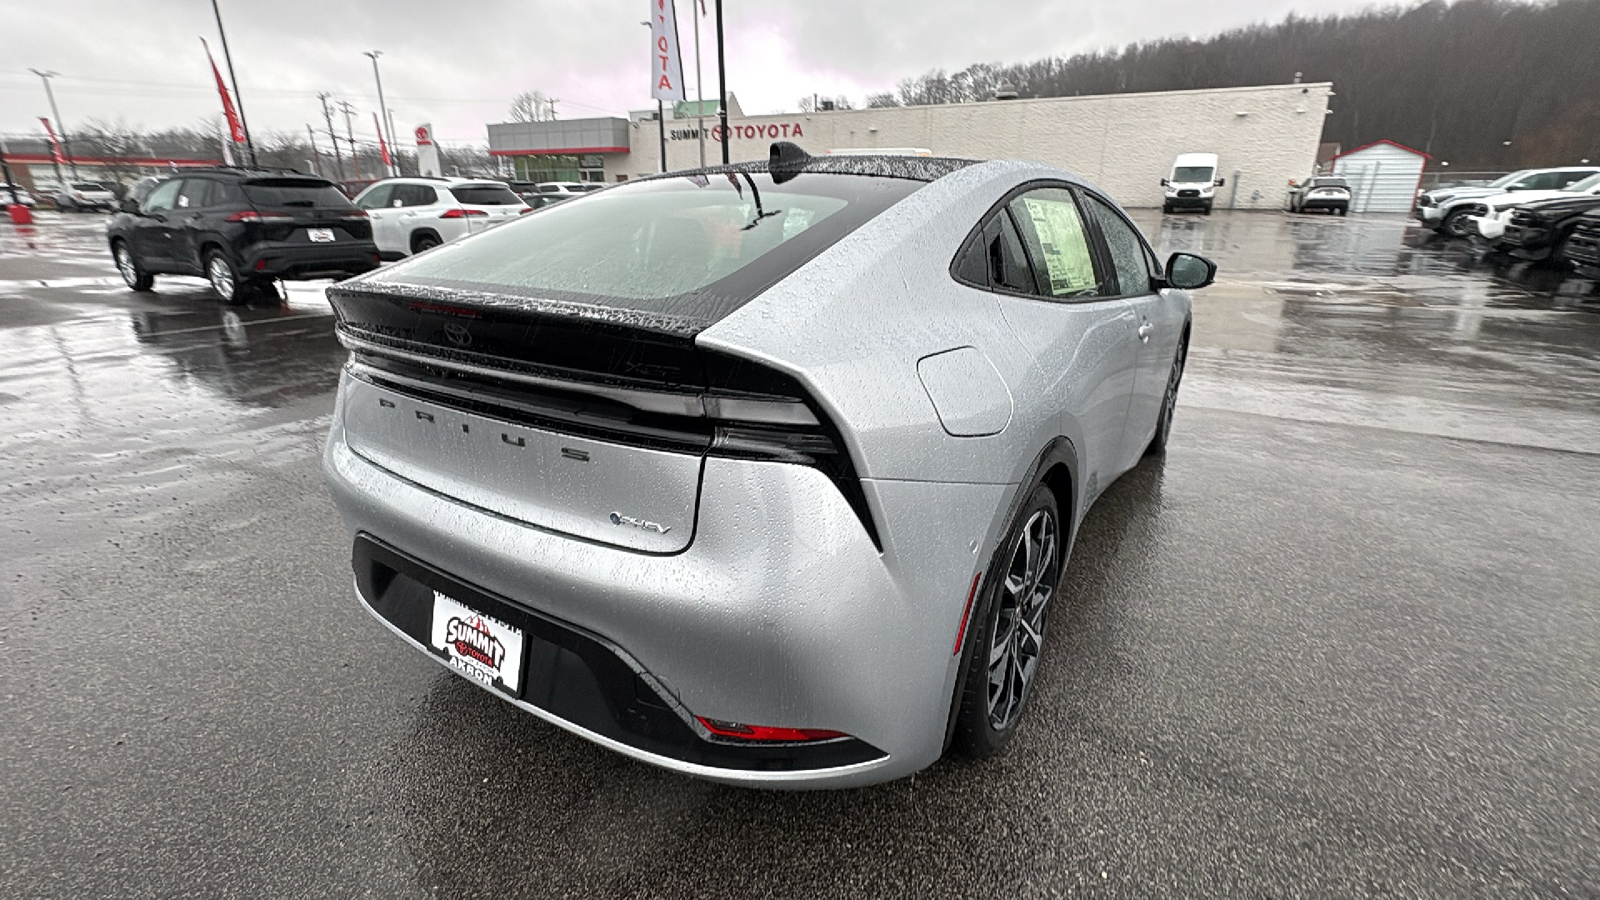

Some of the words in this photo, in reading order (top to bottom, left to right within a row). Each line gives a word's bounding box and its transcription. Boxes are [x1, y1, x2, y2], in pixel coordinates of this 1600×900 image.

[670, 127, 710, 141] SUMMT
[734, 122, 804, 140] TOYOTA
[379, 397, 591, 463] PRIUS
[446, 617, 505, 670] SUMMIT
[467, 646, 493, 667] TOYOTA
[449, 656, 493, 686] AKRON
